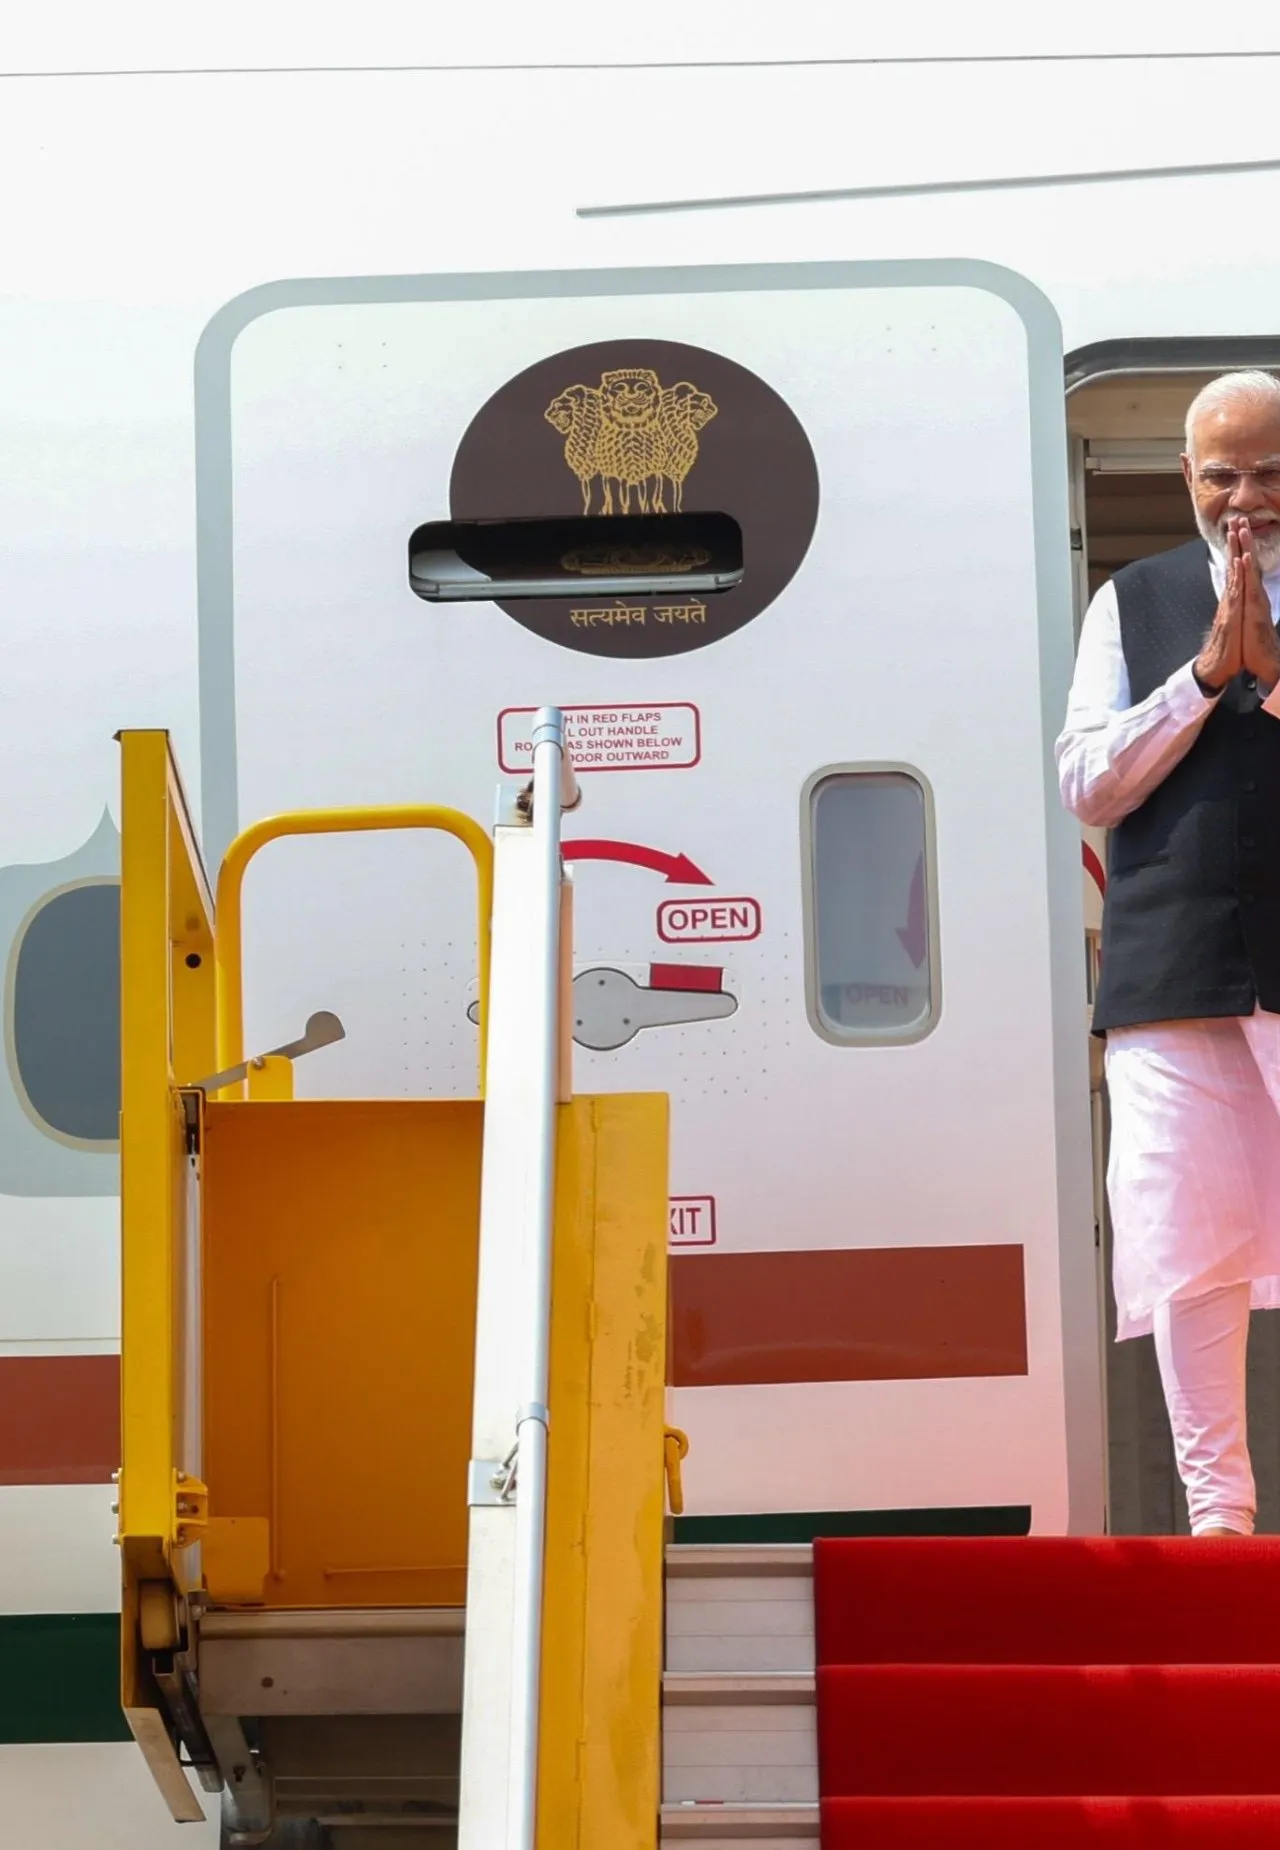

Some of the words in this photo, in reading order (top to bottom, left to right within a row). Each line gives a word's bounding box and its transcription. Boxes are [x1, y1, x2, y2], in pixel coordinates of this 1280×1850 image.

[569, 600, 647, 627] सत्यमेव
[653, 598, 707, 625] जयते
[577, 714, 589, 724] IN
[592, 713, 618, 723] RED
[622, 712, 662, 722] FLAPS
[578, 727, 604, 737] OUT
[607, 725, 659, 736] HANDLE
[567, 741, 583, 750] AS
[586, 739, 633, 749] SHOWN
[637, 737, 683, 748] BELOW
[606, 750, 669, 762] OUTWARD
[667, 906, 749, 931] OPEN
[845, 984, 909, 1007] OPEN
